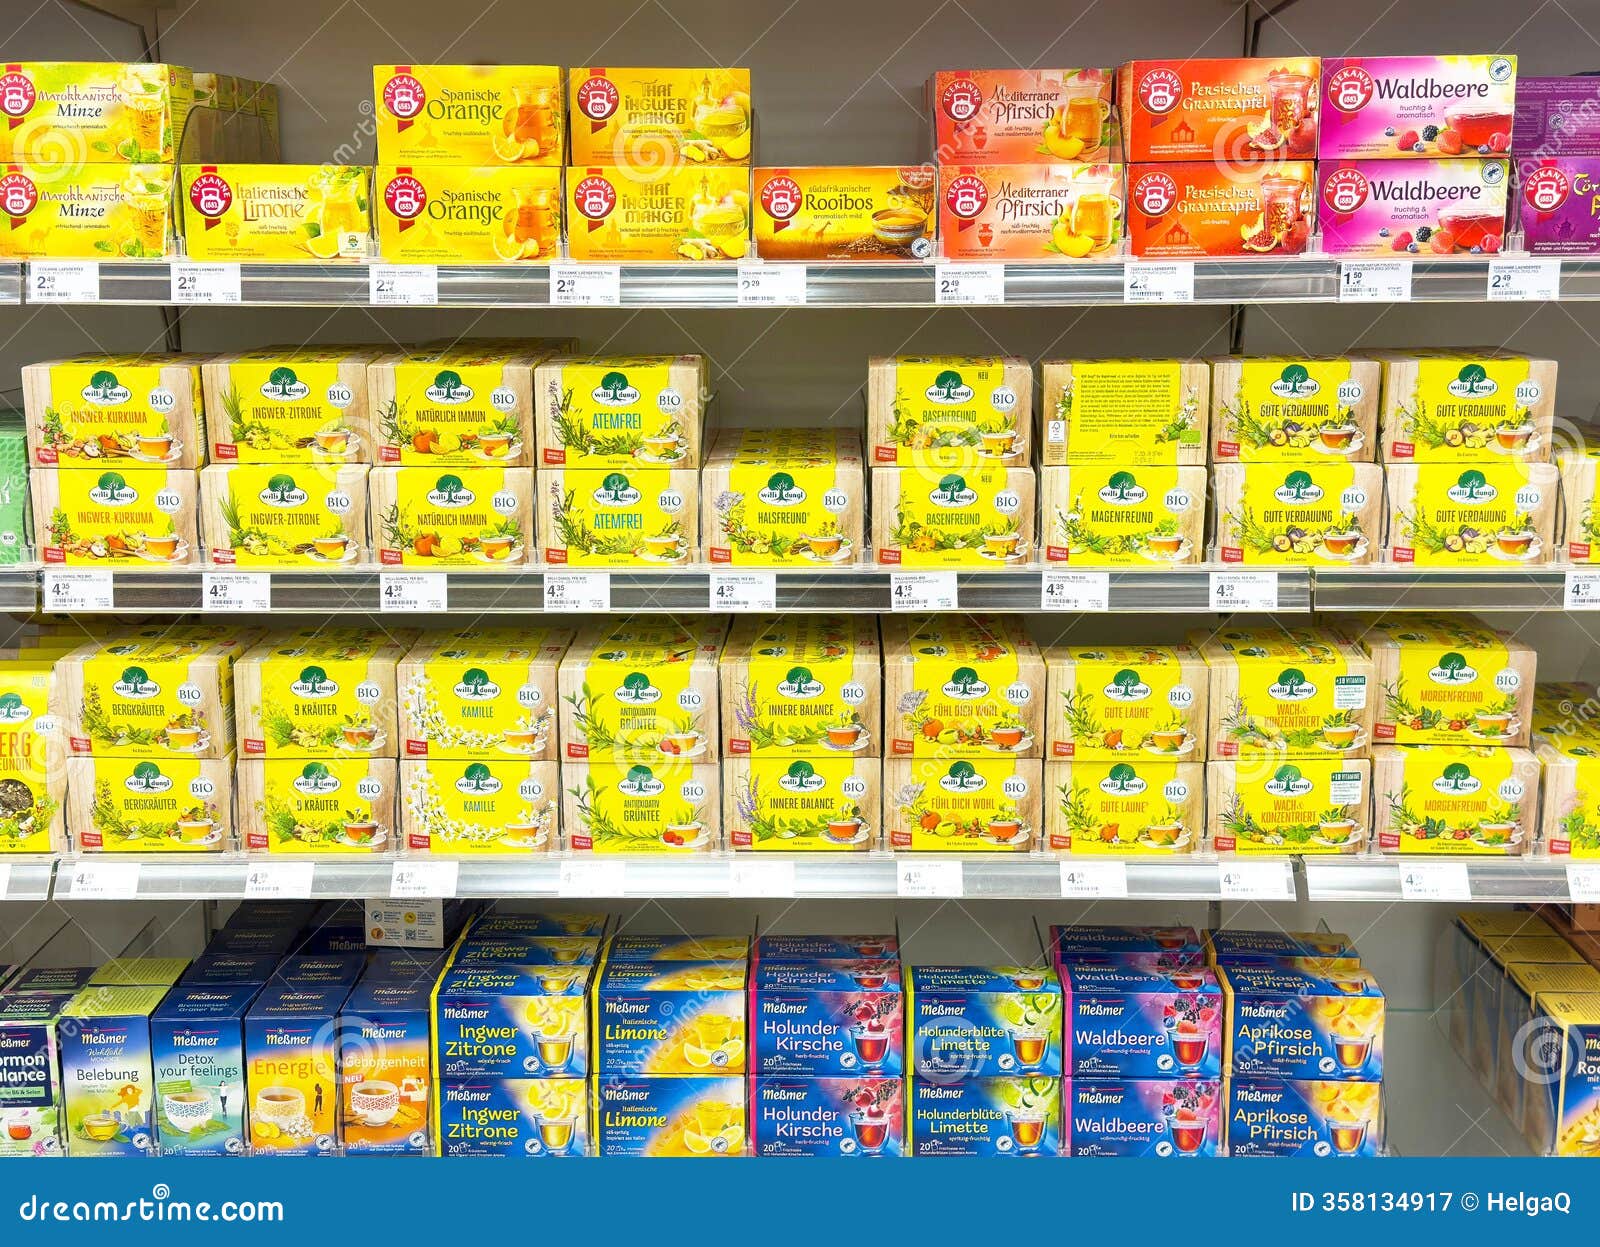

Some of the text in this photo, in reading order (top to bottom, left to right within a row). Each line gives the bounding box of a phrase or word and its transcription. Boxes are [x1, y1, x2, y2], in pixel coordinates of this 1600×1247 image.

[1140, 70, 1180, 94] TEEKANNE
[1330, 69, 1371, 92] TEEKANNE
[38, 84, 122, 102] Marokkanische
[385, 77, 424, 100] TEEKANNE
[988, 84, 1059, 102] Mediterraner
[1191, 82, 1262, 96] Persischer
[1375, 79, 1488, 99] Waldbeere
[441, 89, 500, 102] Spanische
[57, 104, 102, 118] Minze
[991, 102, 1055, 121] Pfirsich
[1183, 98, 1267, 112] Granatapfel
[427, 100, 503, 125] Orange
[1135, 174, 1175, 197] TEEKANNE
[1326, 170, 1368, 193] TEEKANNE
[1526, 169, 1568, 192] TEEKANNE
[41, 184, 125, 202] Marokkanische
[191, 176, 231, 199] TEEKANNE
[236, 183, 309, 199] Italienische
[386, 178, 426, 201] TEEKANNE
[575, 178, 615, 200] TEEKANNE
[761, 179, 801, 201] TEEKANNE
[808, 184, 871, 193] südafrikanischer
[948, 178, 987, 199] TEEKANNE
[991, 181, 1069, 199] Mediterraner
[1185, 185, 1254, 199] Persischer
[1370, 181, 1481, 200] Waldbeere
[442, 189, 501, 203] Spanische
[805, 194, 873, 211] Rooibos
[59, 204, 105, 217] Minze
[242, 201, 304, 221] Limone
[428, 200, 503, 225] Orange
[998, 199, 1063, 220] Pfirsich
[1177, 200, 1261, 214] Granatapfel
[85, 390, 128, 400] willi dungl
[150, 395, 173, 406] BIO
[329, 390, 351, 401] BIO
[252, 406, 322, 420] INGWER-ZITRONE
[922, 410, 977, 423] BASENFREUND
[1260, 404, 1329, 417] GUTE VERDAUUNG
[1437, 405, 1506, 417] GUTE VERDAUUNG
[593, 414, 641, 429] ATEMFREI
[824, 495, 846, 506] BIO
[78, 511, 154, 525] INGWER-KURKUMA
[250, 513, 320, 526] INGWER-ZITRONE
[418, 513, 487, 526] NATÜRLICH IMMUN
[594, 514, 643, 529] ATEMFREI
[926, 513, 980, 526] BASENFREUND
[1091, 510, 1153, 523] MAGENFREUND
[1496, 676, 1518, 686] BIO
[1420, 691, 1482, 702] MORGENFREUND
[112, 703, 165, 716] BERGKRÄUTER
[294, 702, 337, 716] 9 KRÄUTER
[462, 707, 493, 718] KAMILLE
[769, 704, 833, 716] INNERE BALANCE
[1105, 708, 1122, 718] GUTE
[0, 732, 31, 758] ERG
[124, 798, 177, 810] BERGKRÄUTER
[464, 801, 495, 812] KAMILLE
[624, 800, 660, 808] ANTIOXIDATIV
[770, 798, 834, 810] INNERE BALANCE
[932, 797, 995, 809] FÜHL DICH WOHL
[1274, 800, 1296, 811] WACH
[1424, 801, 1487, 812] MORGENFREUND
[624, 809, 660, 822] GRÜNTEE
[1261, 811, 1316, 823] KONZENTRIERT
[467, 974, 520, 982] Ingwer
[444, 1008, 488, 1020] Meßmer
[605, 1002, 649, 1014] Meßmer
[763, 1003, 807, 1014] Meßmer
[921, 1005, 965, 1016] Meßmer
[1079, 1005, 1124, 1016] Meßmer
[1241, 1007, 1286, 1018] Meßmer
[362, 1027, 406, 1039] Meßmer
[460, 1025, 518, 1039] Ingwer
[605, 1025, 667, 1040] Limone
[764, 1021, 839, 1035] Holunder
[919, 1026, 1004, 1038] Holunderblüte
[1238, 1024, 1312, 1041] Aprikose
[81, 1034, 127, 1045] Meßmer
[173, 1036, 219, 1047] Meßmer
[266, 1034, 311, 1045] Meßmer
[777, 1037, 843, 1051] Kirsche
[932, 1040, 990, 1050] Limette
[1076, 1031, 1165, 1046] Waldbeere
[446, 1042, 516, 1056] Zitrone
[1254, 1042, 1323, 1057] Pfirsich
[0, 1056, 45, 1066] ormon
[178, 1055, 214, 1065] Detox
[345, 1056, 425, 1069] Geborgenheit
[1079, 1060, 1089, 1068] 20
[160, 1065, 238, 1078] your feelings
[255, 1058, 326, 1076] Energie
[446, 1063, 456, 1072] 20
[0, 1069, 46, 1081] alance
[77, 1069, 138, 1083] Belebung
[345, 1075, 362, 1083] NEU
[605, 1090, 649, 1101] Meßmer
[920, 1088, 963, 1099] Meßmer
[1078, 1093, 1123, 1104] Meßmer
[462, 1107, 520, 1121] Ingwer
[605, 1112, 666, 1127] Limone
[764, 1107, 839, 1121] Holunder
[917, 1108, 1002, 1120] Holunderblüte
[1234, 1108, 1307, 1125] Aprikose
[448, 1124, 518, 1138] Zitrone
[776, 1123, 843, 1137] Kirsche
[931, 1122, 988, 1133] Limette
[1076, 1118, 1164, 1133] Waldbeere
[1250, 1126, 1317, 1141] Pfirsich
